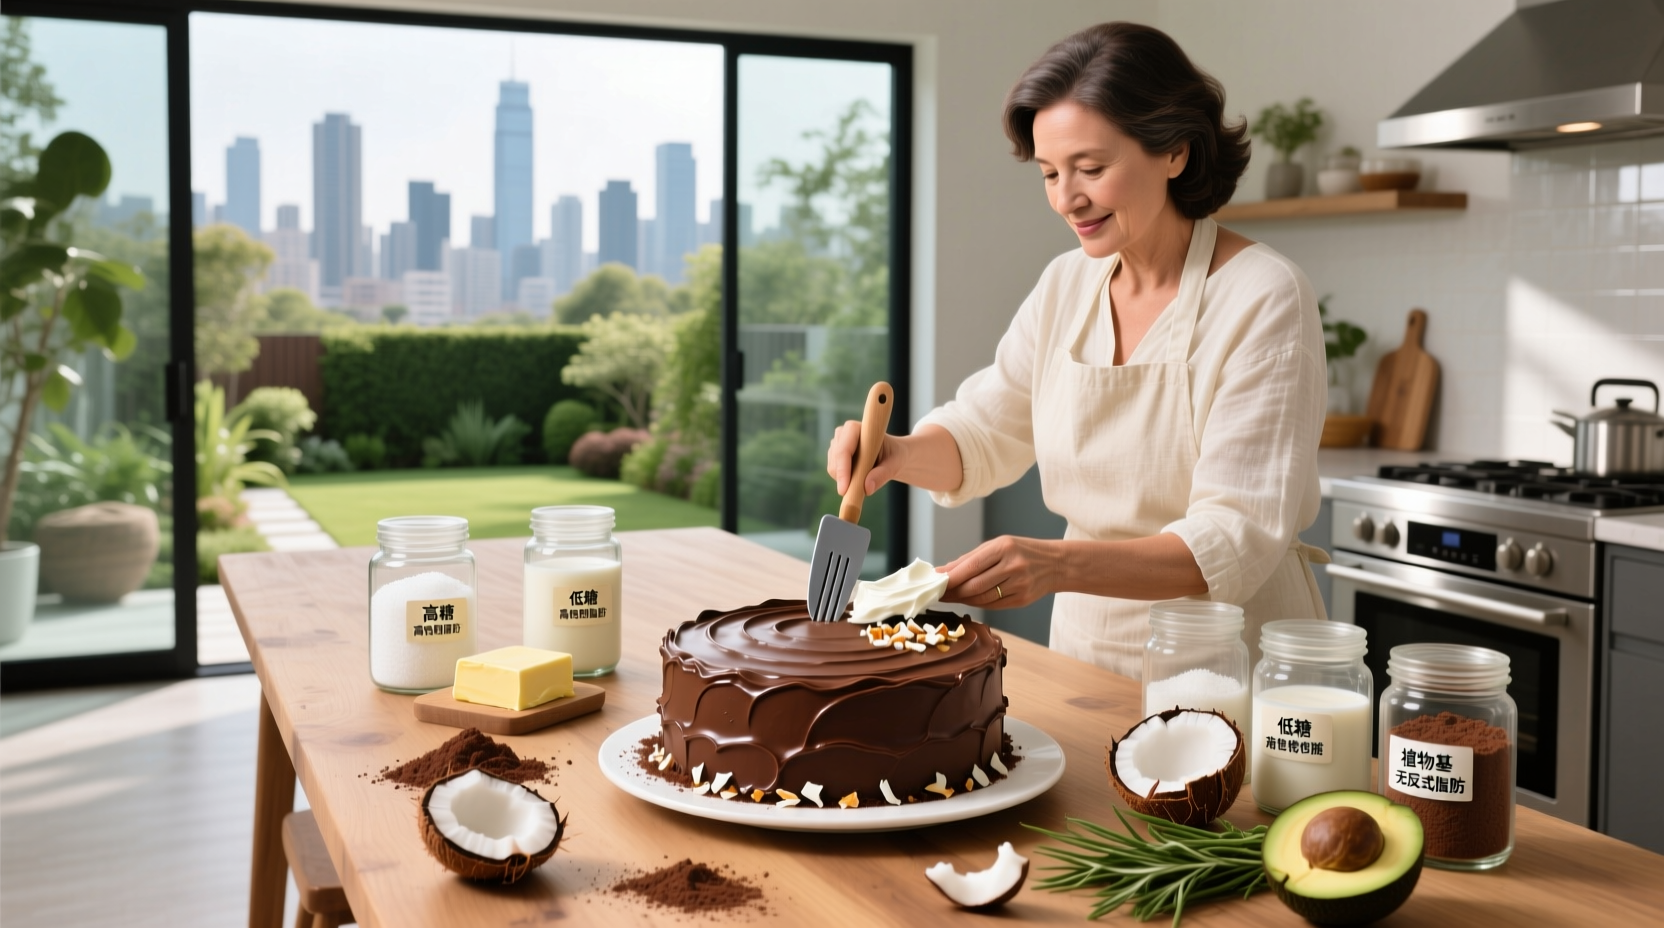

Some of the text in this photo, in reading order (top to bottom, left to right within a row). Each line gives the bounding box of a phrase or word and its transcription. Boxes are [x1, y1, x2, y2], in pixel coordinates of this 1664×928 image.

[422, 603, 455, 623] 高糖
[1277, 716, 1312, 738] 低糖
[1401, 747, 1453, 773] 植物基
